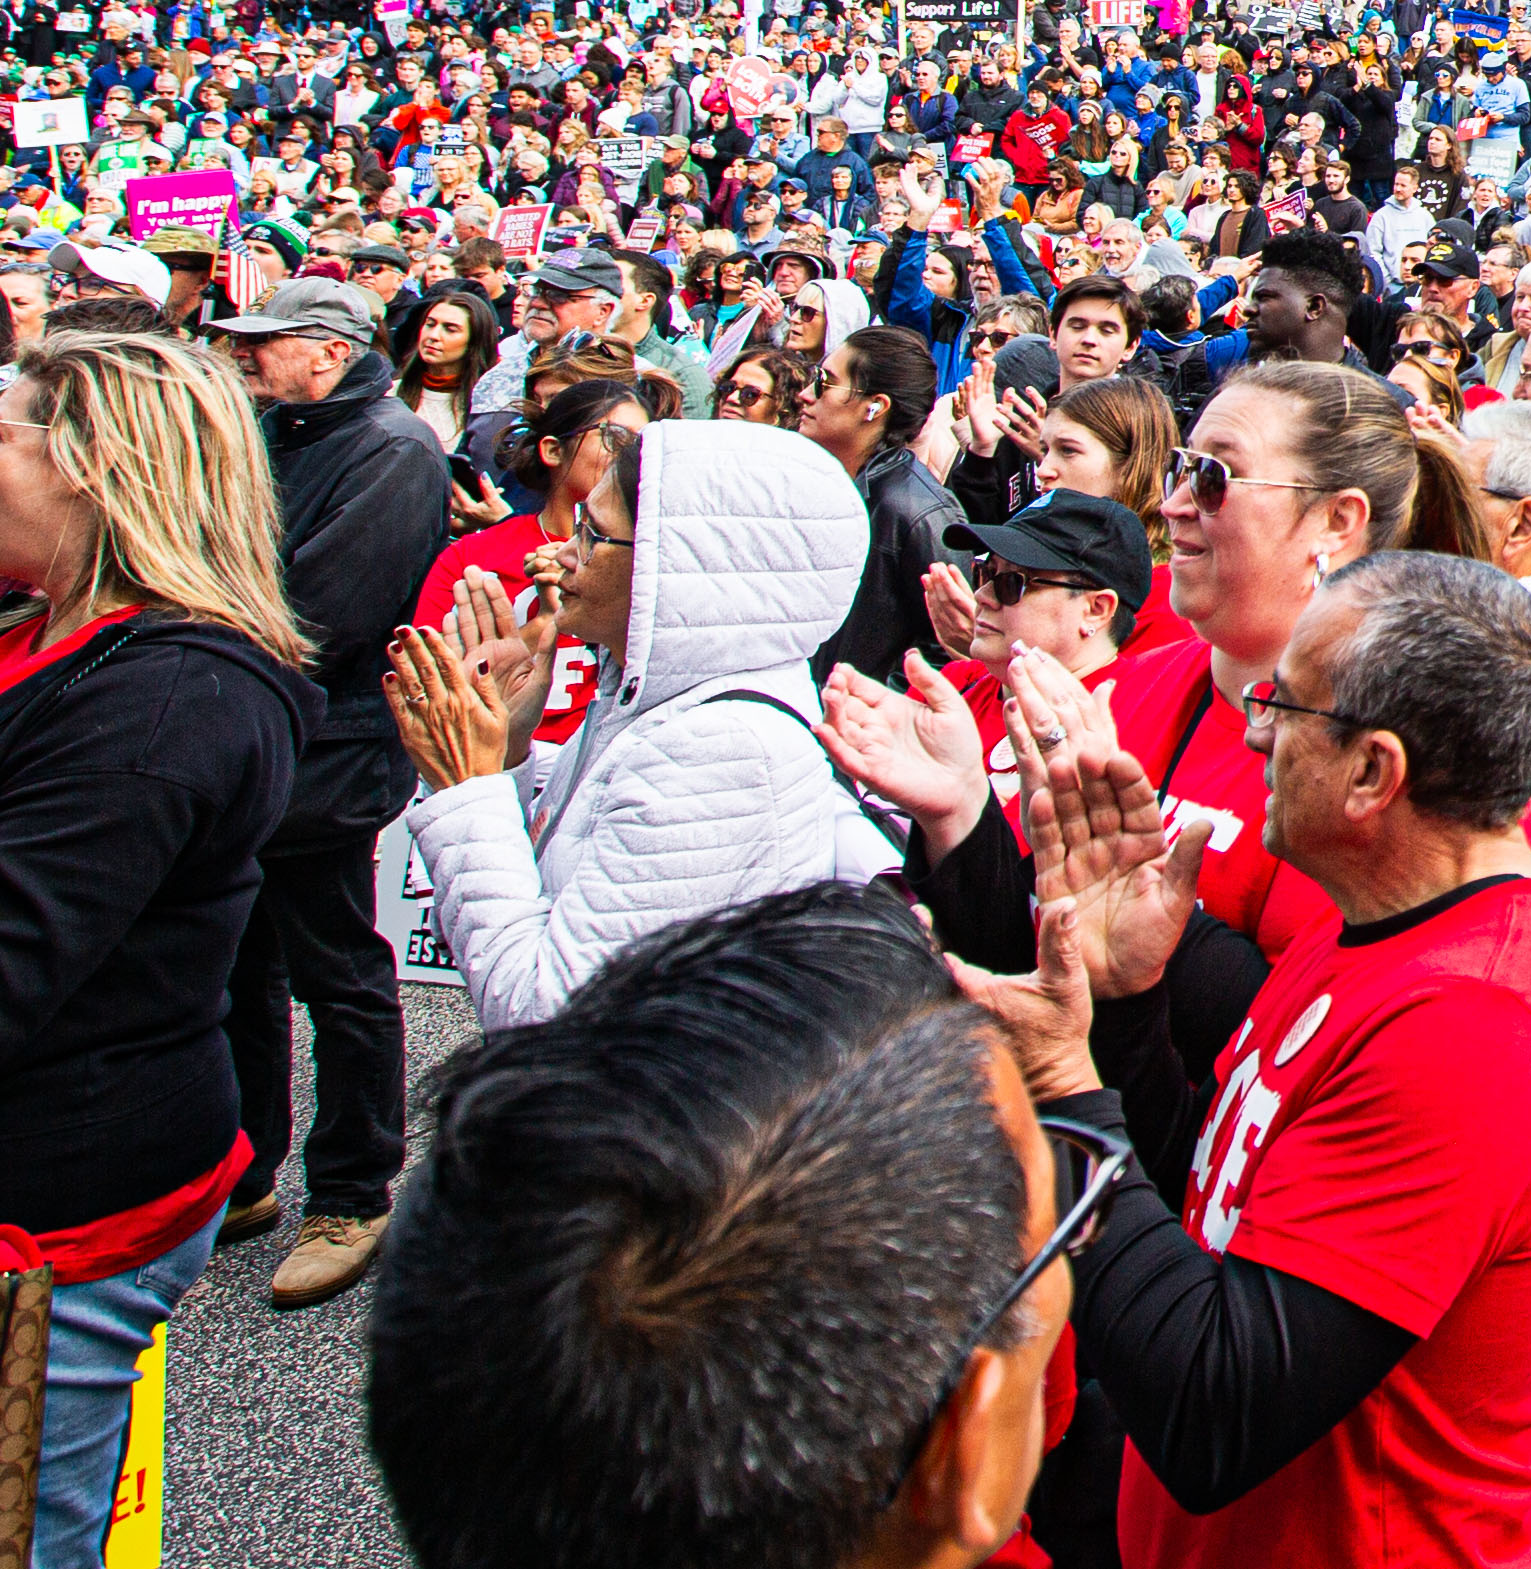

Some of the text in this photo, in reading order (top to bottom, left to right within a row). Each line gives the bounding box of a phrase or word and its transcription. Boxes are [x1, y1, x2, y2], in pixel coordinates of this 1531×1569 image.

[906, 2, 999, 18] Support Life!
[1100, 1, 1143, 24] LIFE
[137, 195, 233, 215] I'm happy
